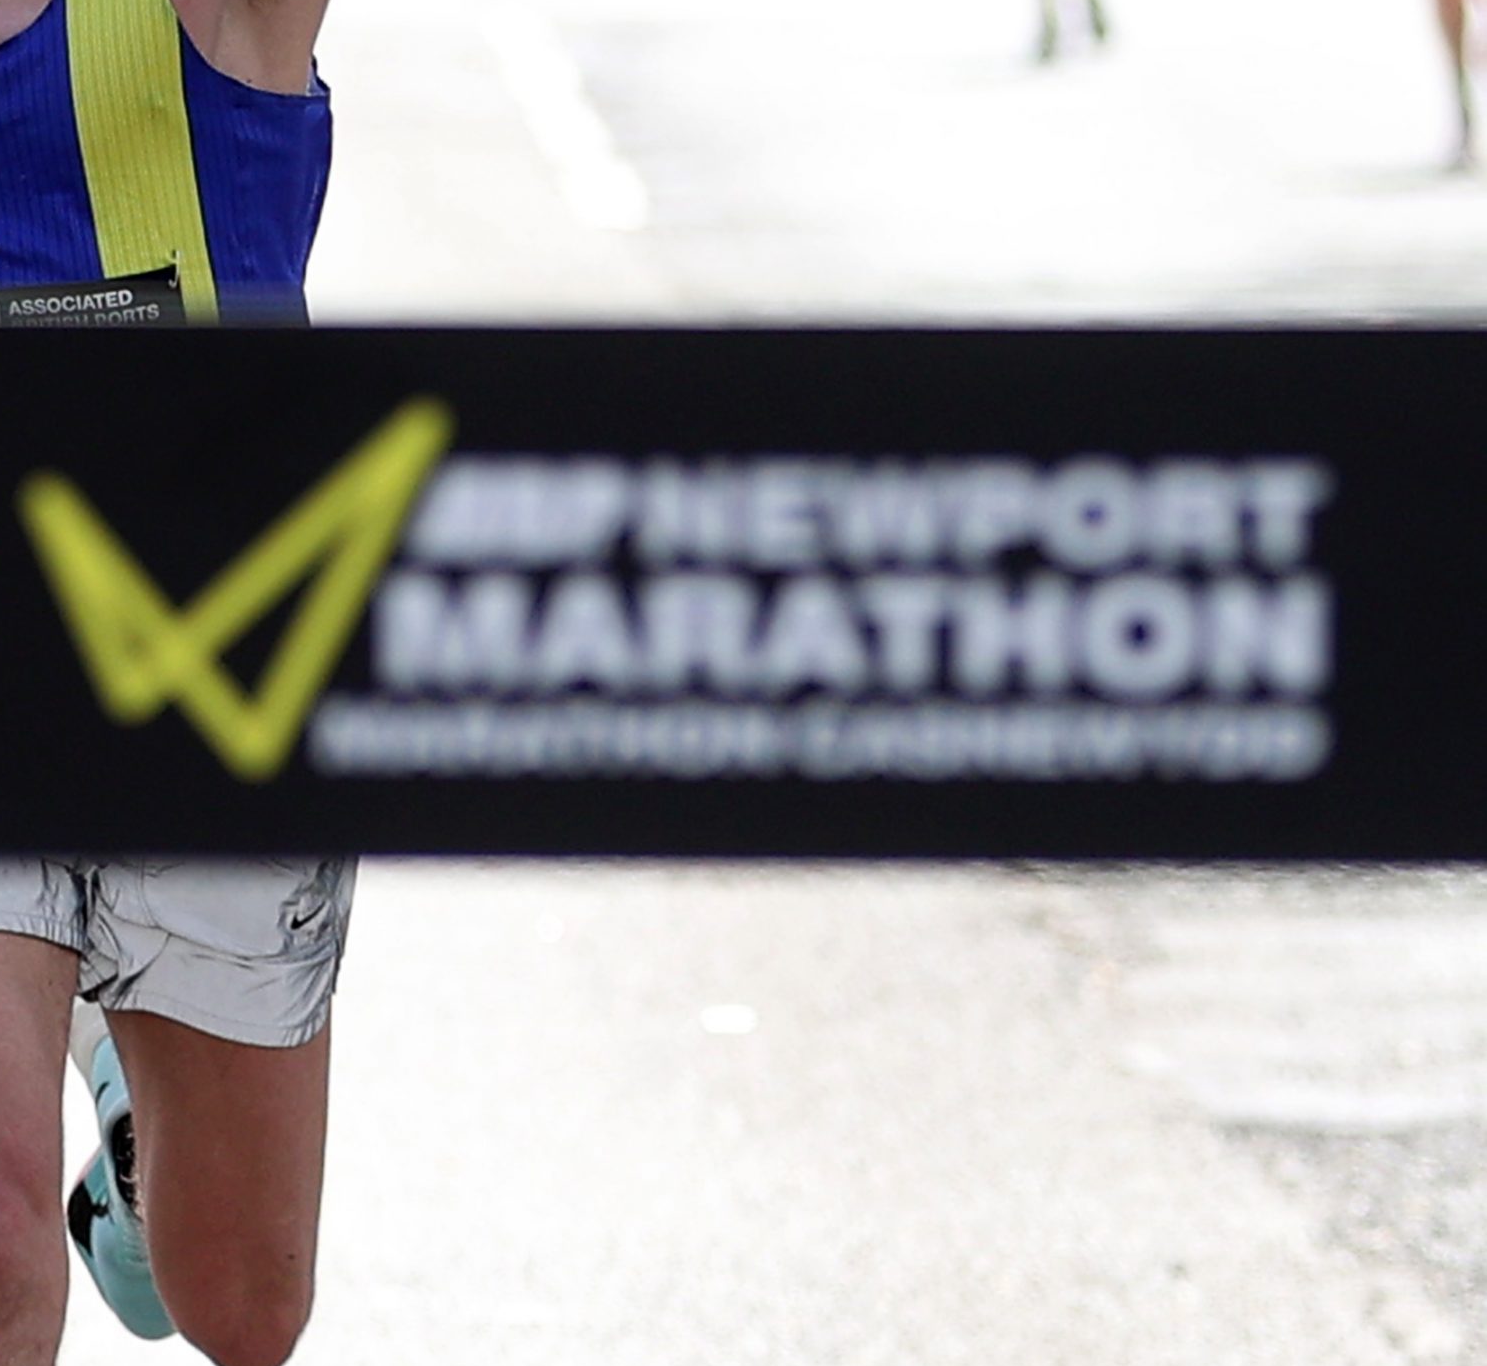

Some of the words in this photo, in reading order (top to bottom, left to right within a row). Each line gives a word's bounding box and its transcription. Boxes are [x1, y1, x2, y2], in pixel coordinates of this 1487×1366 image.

[9, 288, 134, 316] ASSOCIATED
[94, 303, 161, 328] PORTS
[638, 457, 1332, 567] NEWPORT
[378, 571, 1332, 699] MARATHON
